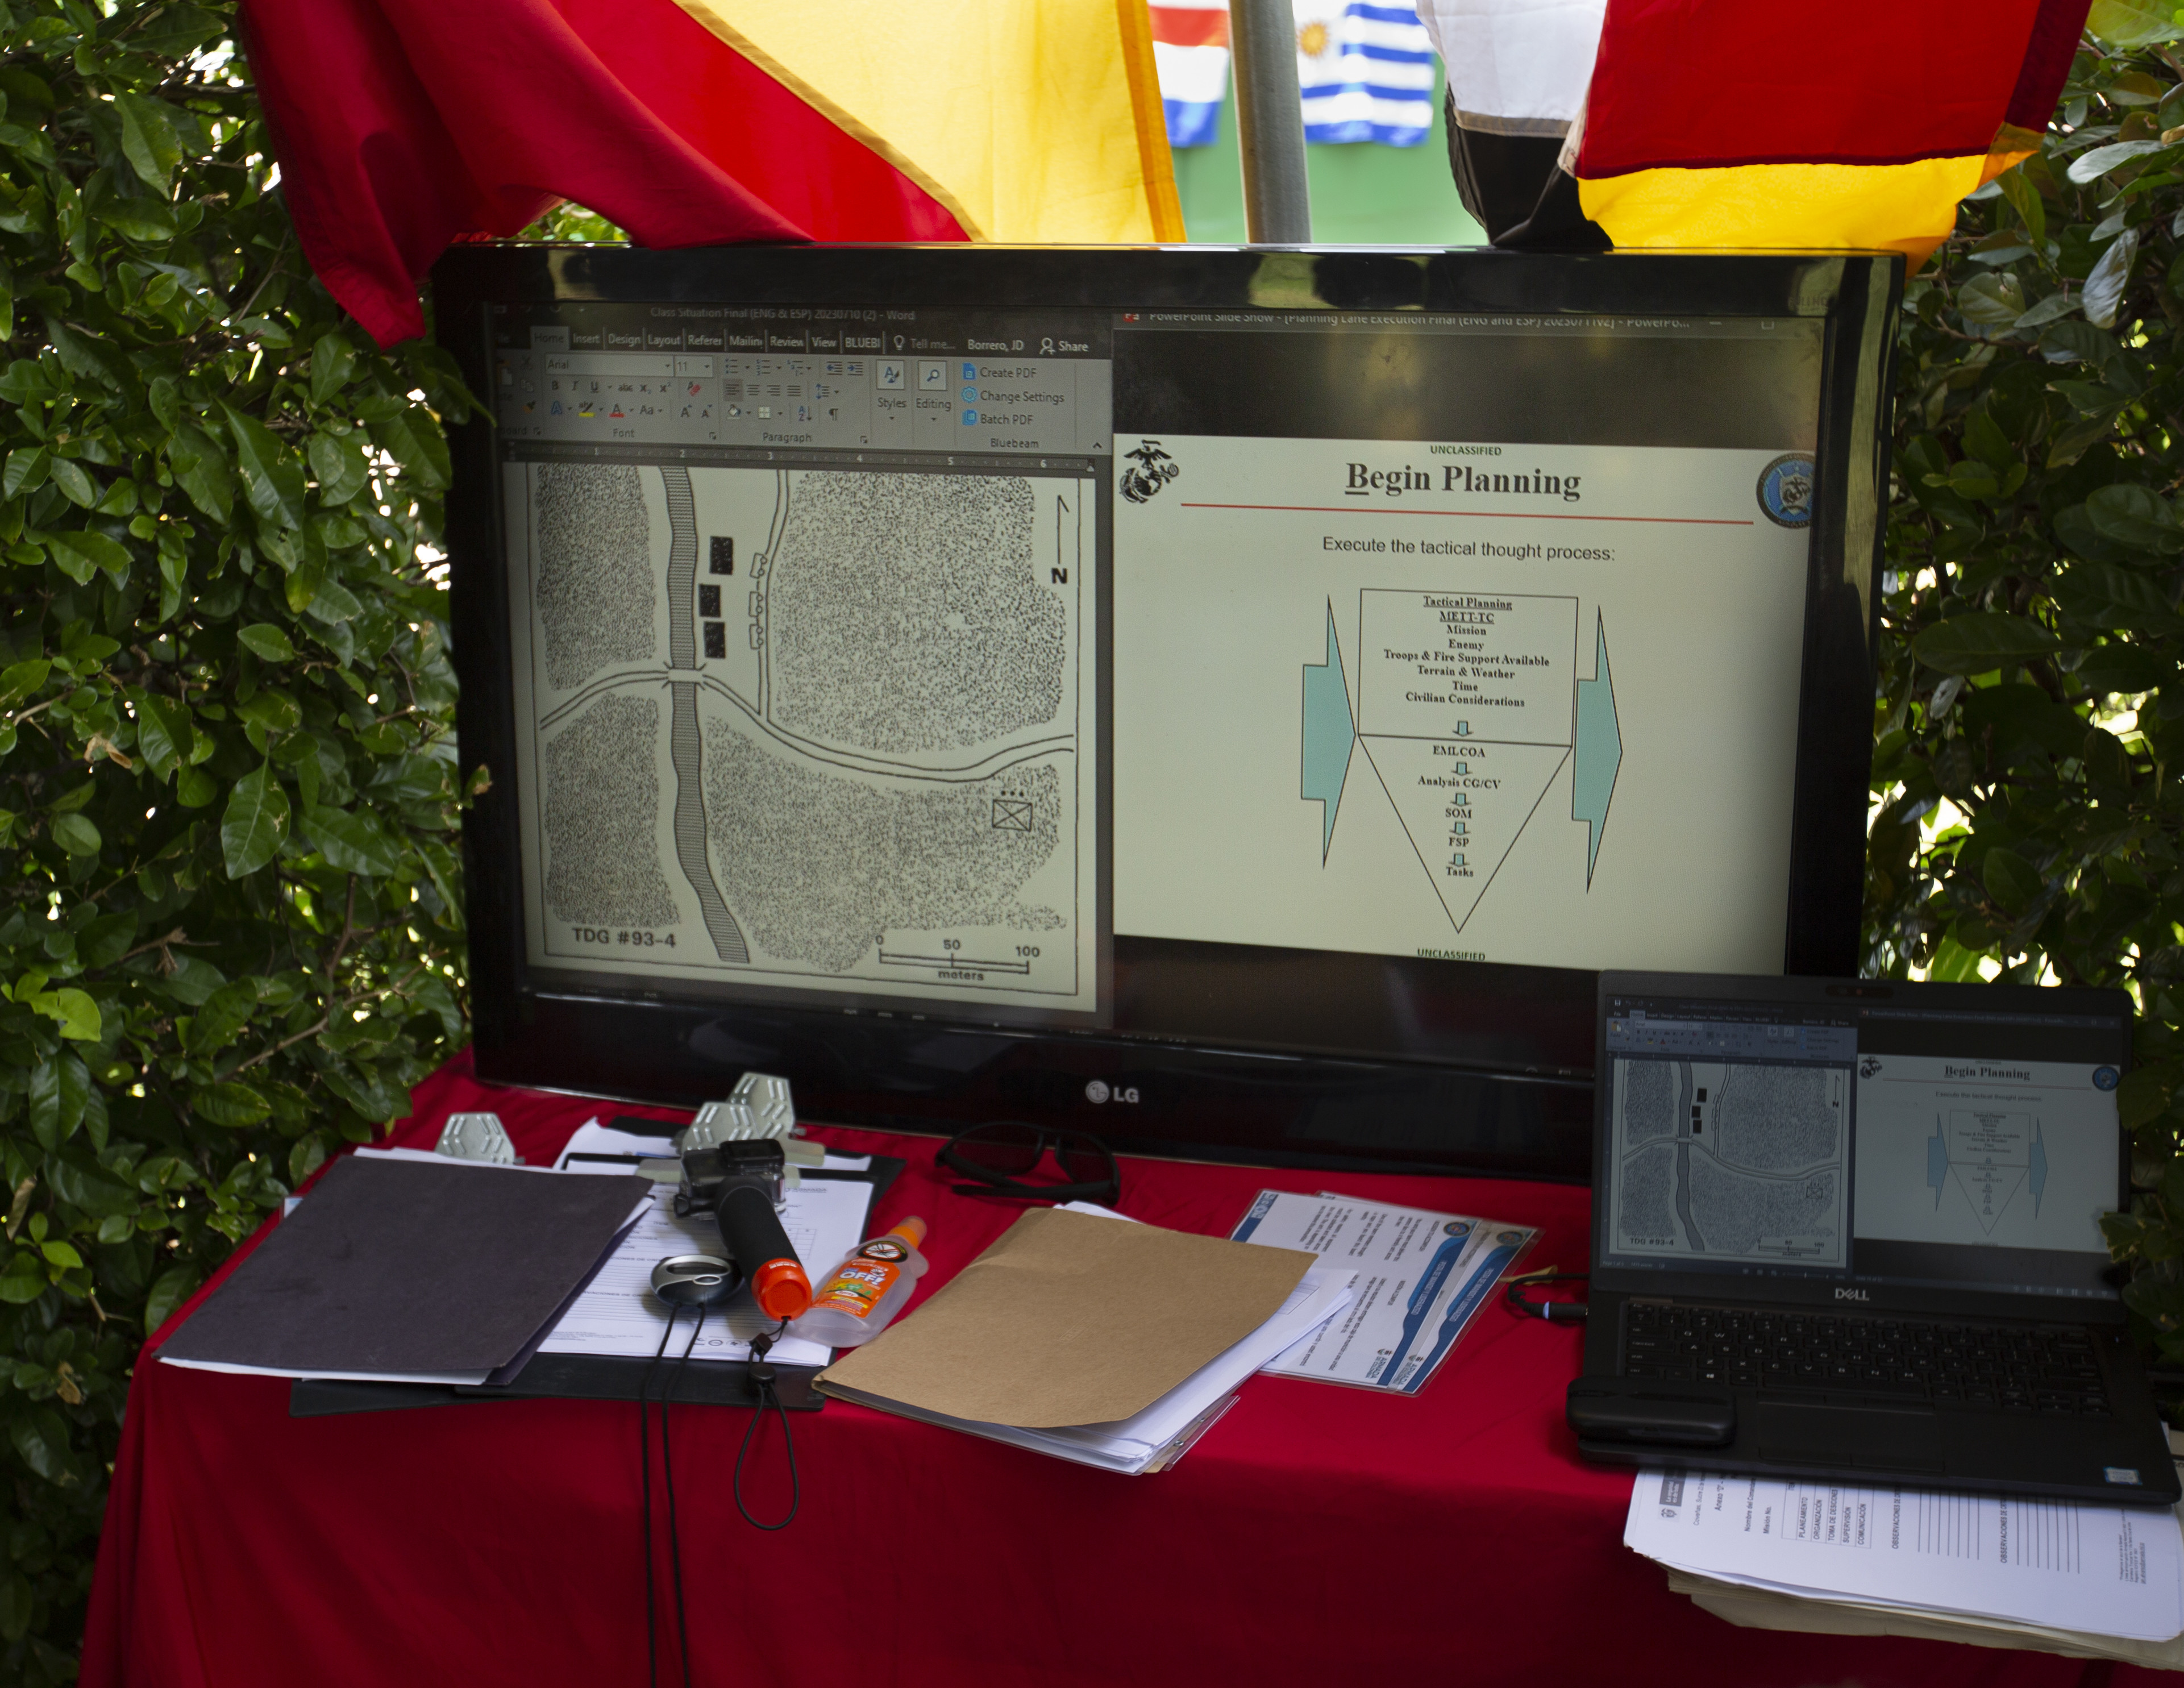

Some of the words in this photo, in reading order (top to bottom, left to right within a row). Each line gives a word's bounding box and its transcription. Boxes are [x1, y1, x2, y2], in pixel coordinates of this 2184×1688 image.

[650, 307, 676, 318] Class
[678, 307, 721, 318] Situation
[724, 307, 748, 318] Final
[750, 308, 775, 320] (ENG
[777, 309, 788, 318] &
[790, 309, 812, 321] ESP)
[863, 310, 876, 322] (2)
[887, 311, 916, 321] Word
[1150, 313, 1212, 322] PowerPoint
[1214, 314, 1241, 323] Slide
[1244, 314, 1273, 323] Show
[534, 332, 565, 342] Home
[573, 333, 600, 344] Insert
[609, 334, 641, 347] Design
[648, 334, 681, 348] Layout
[812, 336, 837, 348] View
[911, 339, 929, 350] Tell
[930, 341, 956, 350] me...
[968, 340, 1009, 352] Borrero,
[1011, 339, 1024, 351] JD
[1058, 341, 1089, 352] Share
[547, 359, 569, 370] Arial
[677, 361, 687, 371] 11
[980, 367, 1014, 378] Create
[1016, 368, 1037, 379] PDF
[877, 397, 906, 410] Styles
[916, 398, 951, 411] Editing
[980, 391, 1021, 404] Change
[1023, 392, 1064, 405] Settings
[980, 414, 1010, 425] Batch
[1013, 415, 1033, 425] PDF
[613, 427, 635, 438] Font
[763, 432, 813, 444] Paragraph
[990, 438, 1039, 449] Bluebeam
[1430, 445, 1502, 456] UNCLASSIFIED
[1345, 463, 1432, 497] Begin
[1441, 465, 1582, 502] Planning
[1322, 536, 1386, 553] Execute
[1391, 538, 1415, 554] the
[1421, 541, 1476, 556] tactical
[1481, 543, 1542, 561] thought
[1547, 546, 1615, 562] process:
[1051, 568, 1068, 584] N
[1423, 596, 1463, 608] Tactical
[1466, 597, 1512, 610] Planning
[1440, 610, 1495, 624] METT-TC
[1446, 625, 1487, 636] Mission
[1449, 639, 1484, 652] Enemy
[1384, 649, 1418, 662] Troops
[1421, 651, 1430, 661] &
[1434, 652, 1455, 662] Fire
[1458, 653, 1499, 666] Support
[1502, 655, 1550, 667] Available
[1417, 665, 1455, 676] Terrain
[1458, 667, 1467, 676] &
[1471, 668, 1515, 679] Weather
[1452, 681, 1478, 692] Time
[1405, 692, 1445, 703] Civilian
[1448, 694, 1525, 707] Considerations
[1433, 745, 1486, 758] EMLCOA
[1418, 775, 1460, 788] Analysis
[1463, 778, 1501, 789] CG/CV
[1445, 808, 1472, 819] SOM
[1449, 837, 1470, 847] FSP
[1446, 867, 1474, 878] Tasks
[572, 927, 610, 945] TDG
[618, 928, 676, 948] #93-4
[875, 934, 884, 946] 0
[943, 938, 961, 951] 50
[1016, 945, 1041, 958] 100
[1417, 948, 1486, 962] UNCLASSIFIED
[938, 969, 984, 982] meters
[1944, 1065, 1977, 1079] Begin
[1980, 1066, 2031, 1081] Planning
[1113, 1086, 1140, 1104] LG
[839, 1271, 886, 1286] OFF!
[1834, 1288, 1870, 1302] DELL
[1714, 1493, 1723, 1511] Anexo
[1744, 1510, 1753, 1532] Nombre
[1799, 1496, 1808, 1538] PLANEAMIENTO
[1813, 1499, 1823, 1540] ORGANIZACIÓN
[1857, 1503, 1866, 1545] COMUNICACIÓN
[1842, 1507, 1852, 1543] SUPERVISIÓN
[1891, 1504, 1901, 1549] OBSERVACIONES
